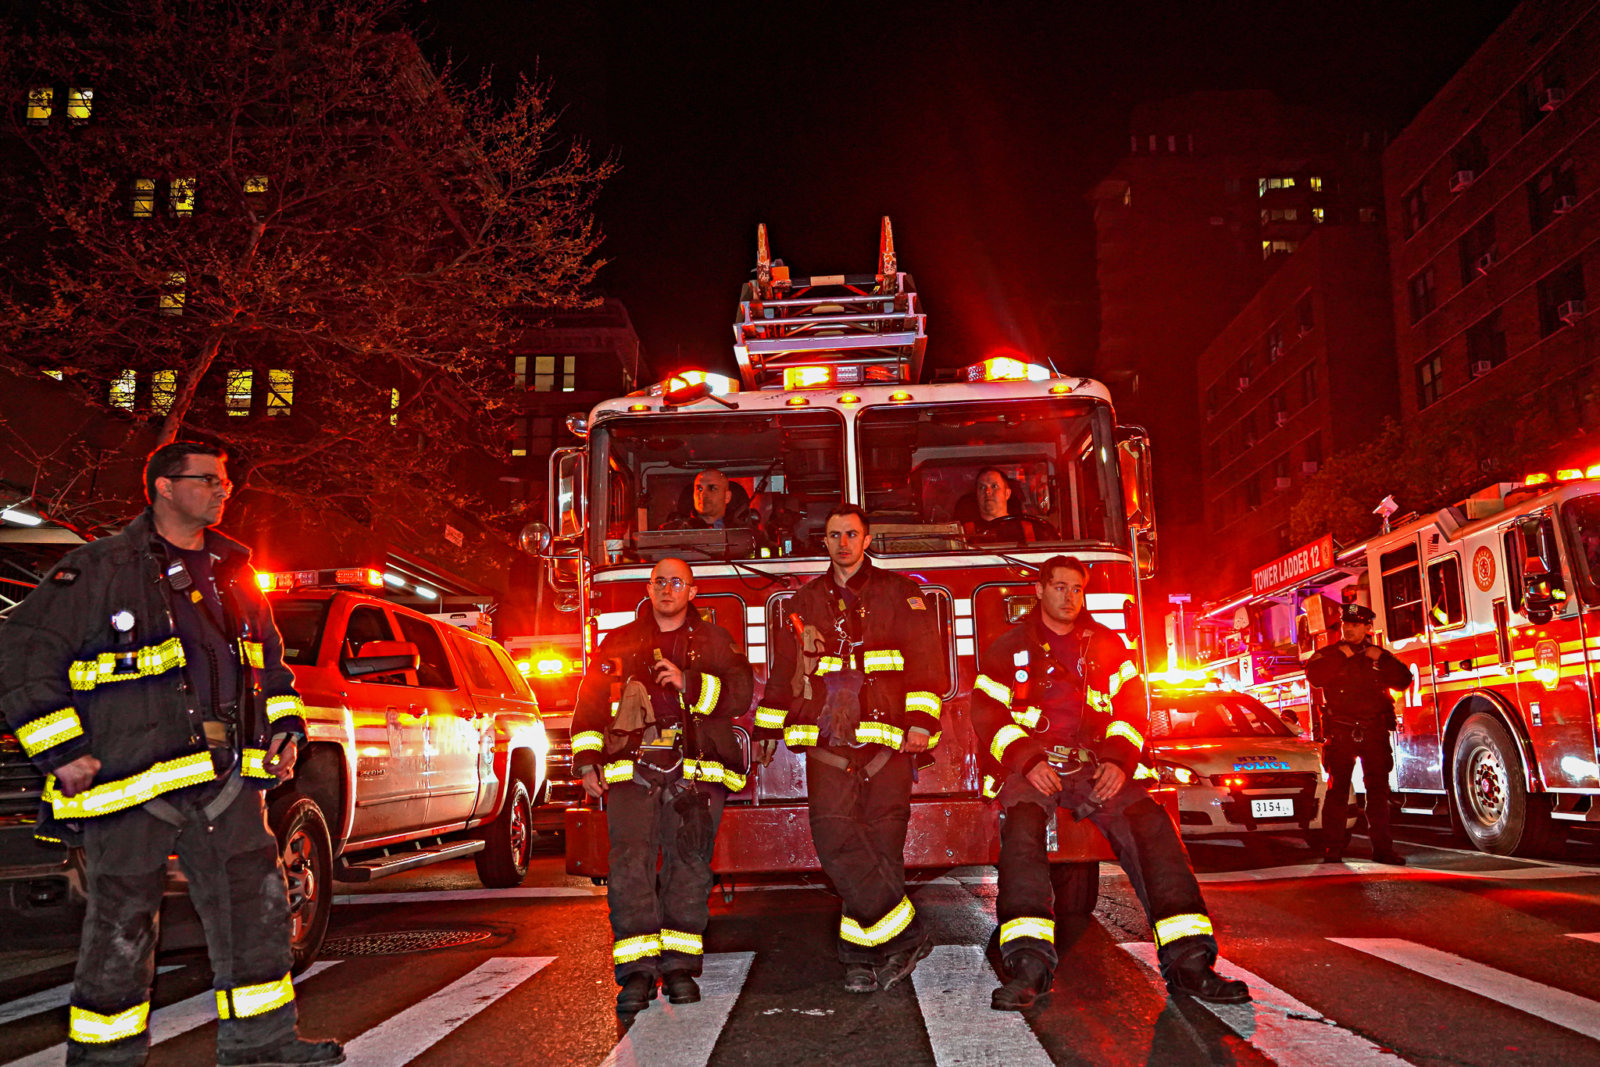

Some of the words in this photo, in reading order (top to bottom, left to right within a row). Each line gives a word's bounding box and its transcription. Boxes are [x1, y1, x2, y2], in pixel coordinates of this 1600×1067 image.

[1254, 564, 1278, 592] TOWER
[1279, 550, 1310, 582] LADDER
[1310, 545, 1320, 568] 12
[1233, 762, 1291, 771] POLICE
[1256, 802, 1281, 812] 3154
